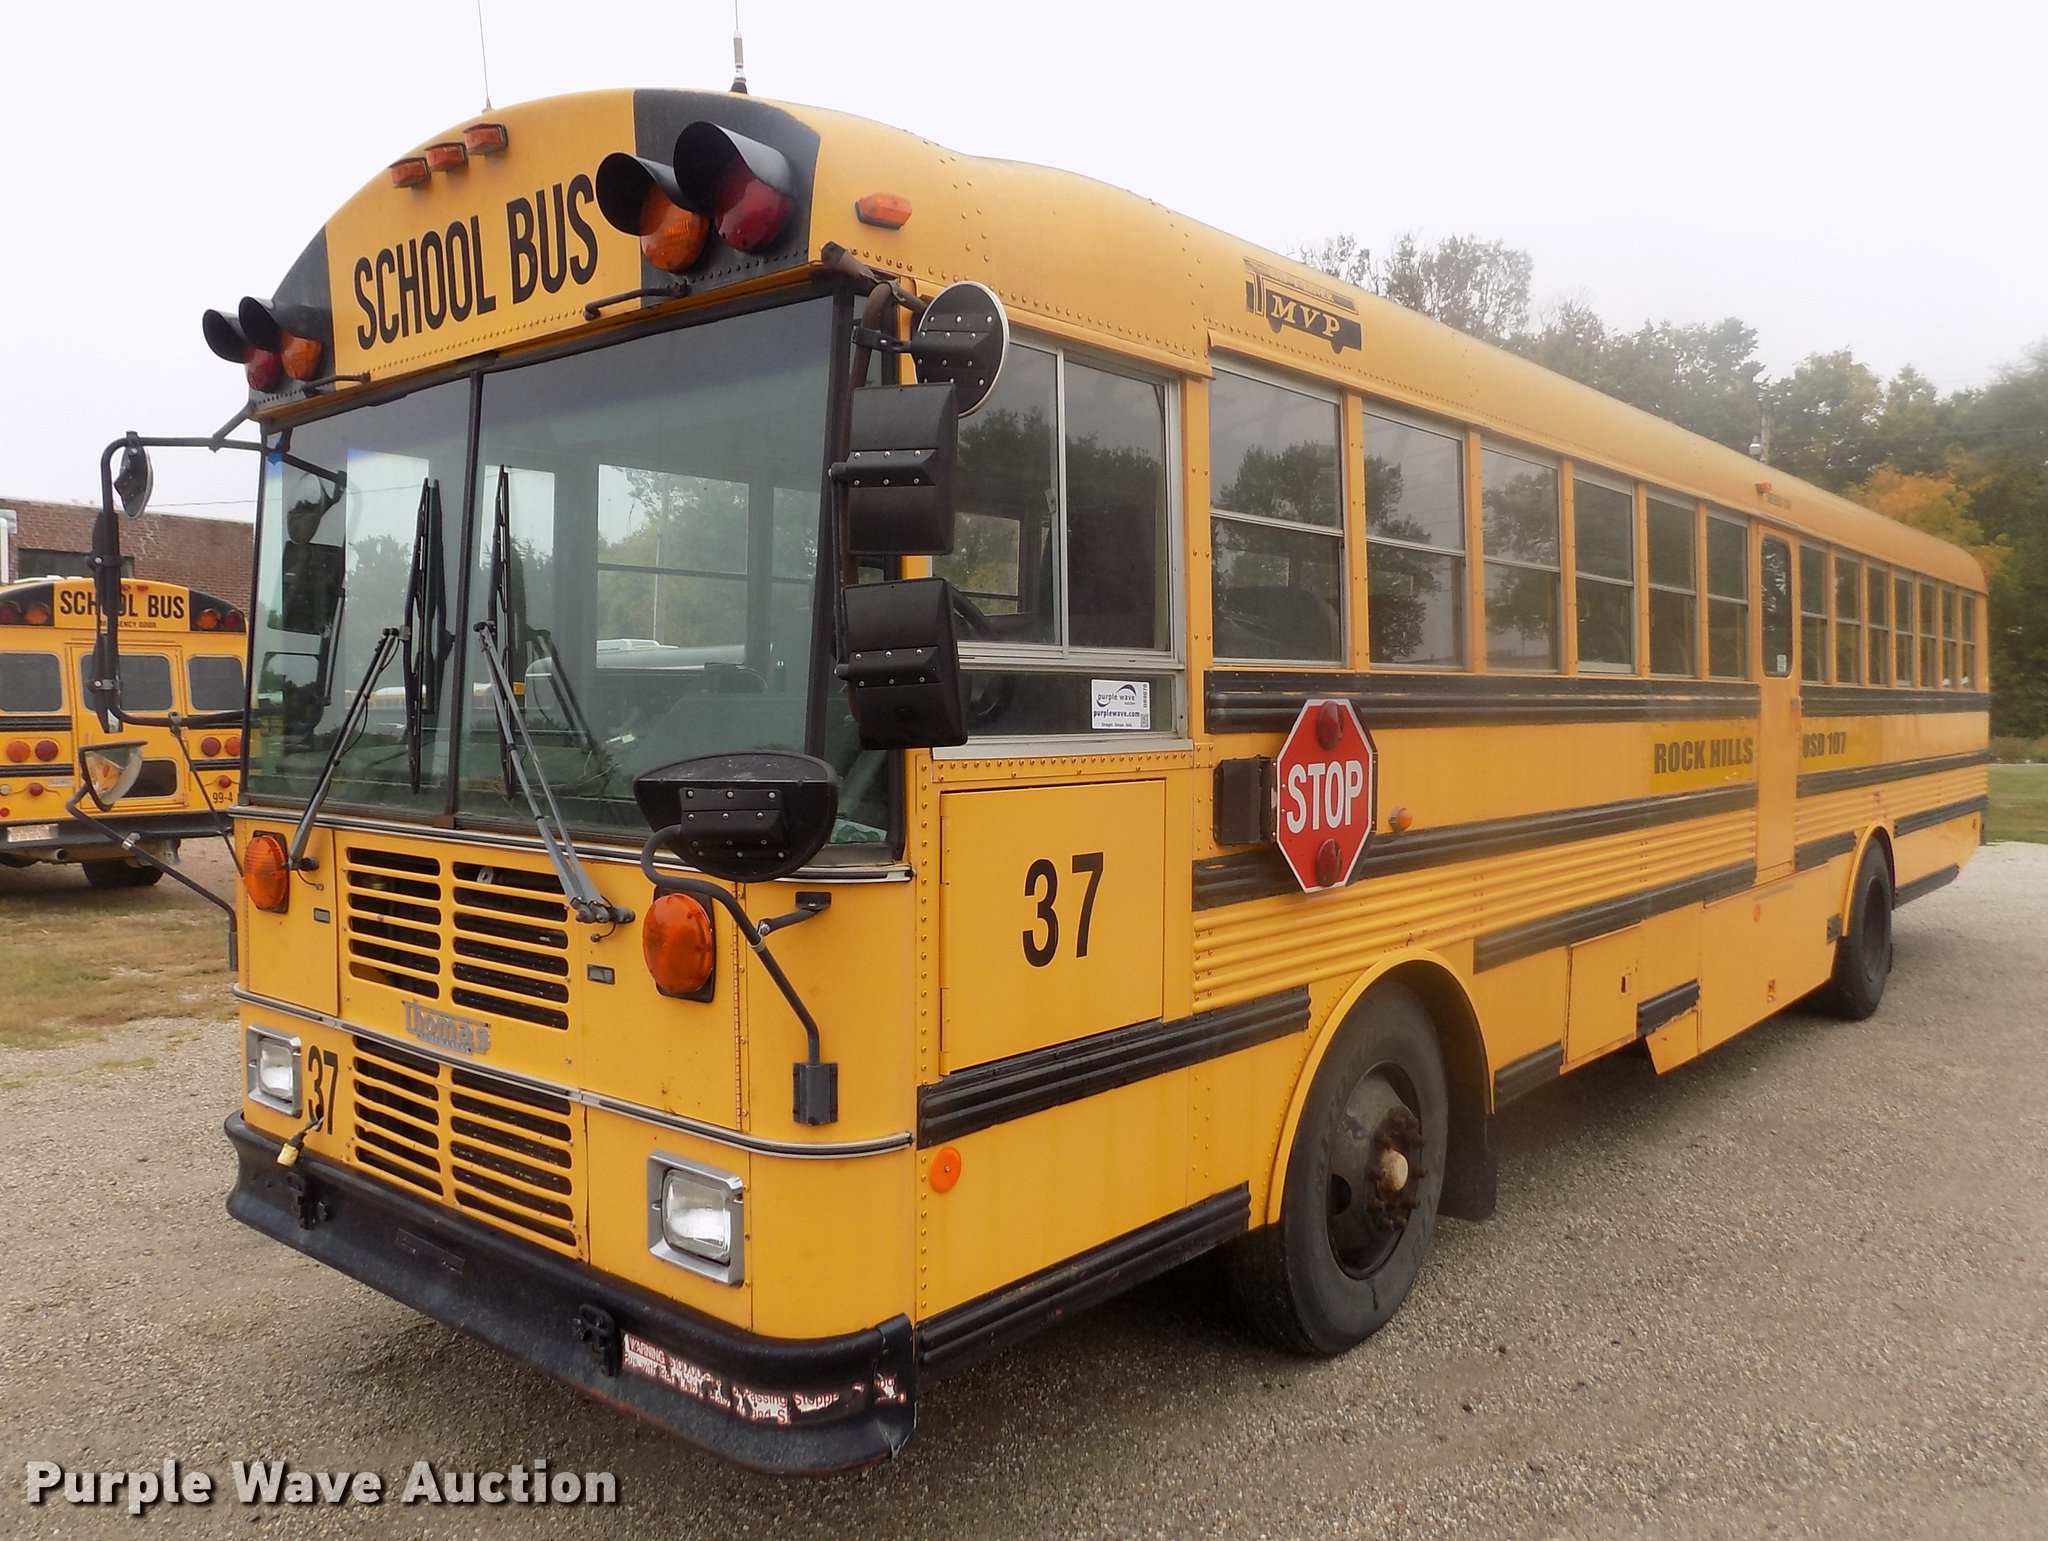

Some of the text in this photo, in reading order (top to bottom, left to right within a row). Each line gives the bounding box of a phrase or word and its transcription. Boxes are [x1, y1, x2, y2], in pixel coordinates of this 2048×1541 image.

[354, 174, 598, 350] SCHOOL BUS
[1270, 295, 1340, 337] MVP
[148, 595, 184, 618] BUS
[1093, 709, 1140, 718] purplewave.com
[1098, 693, 1118, 701] purple
[1654, 737, 1753, 774] ROCK HILLS
[1802, 733, 1825, 758] USD
[1287, 760, 1363, 833] STOP
[1022, 851, 1104, 968] 37
[308, 1045, 338, 1135] 37
[629, 1336, 666, 1365] WARNING
